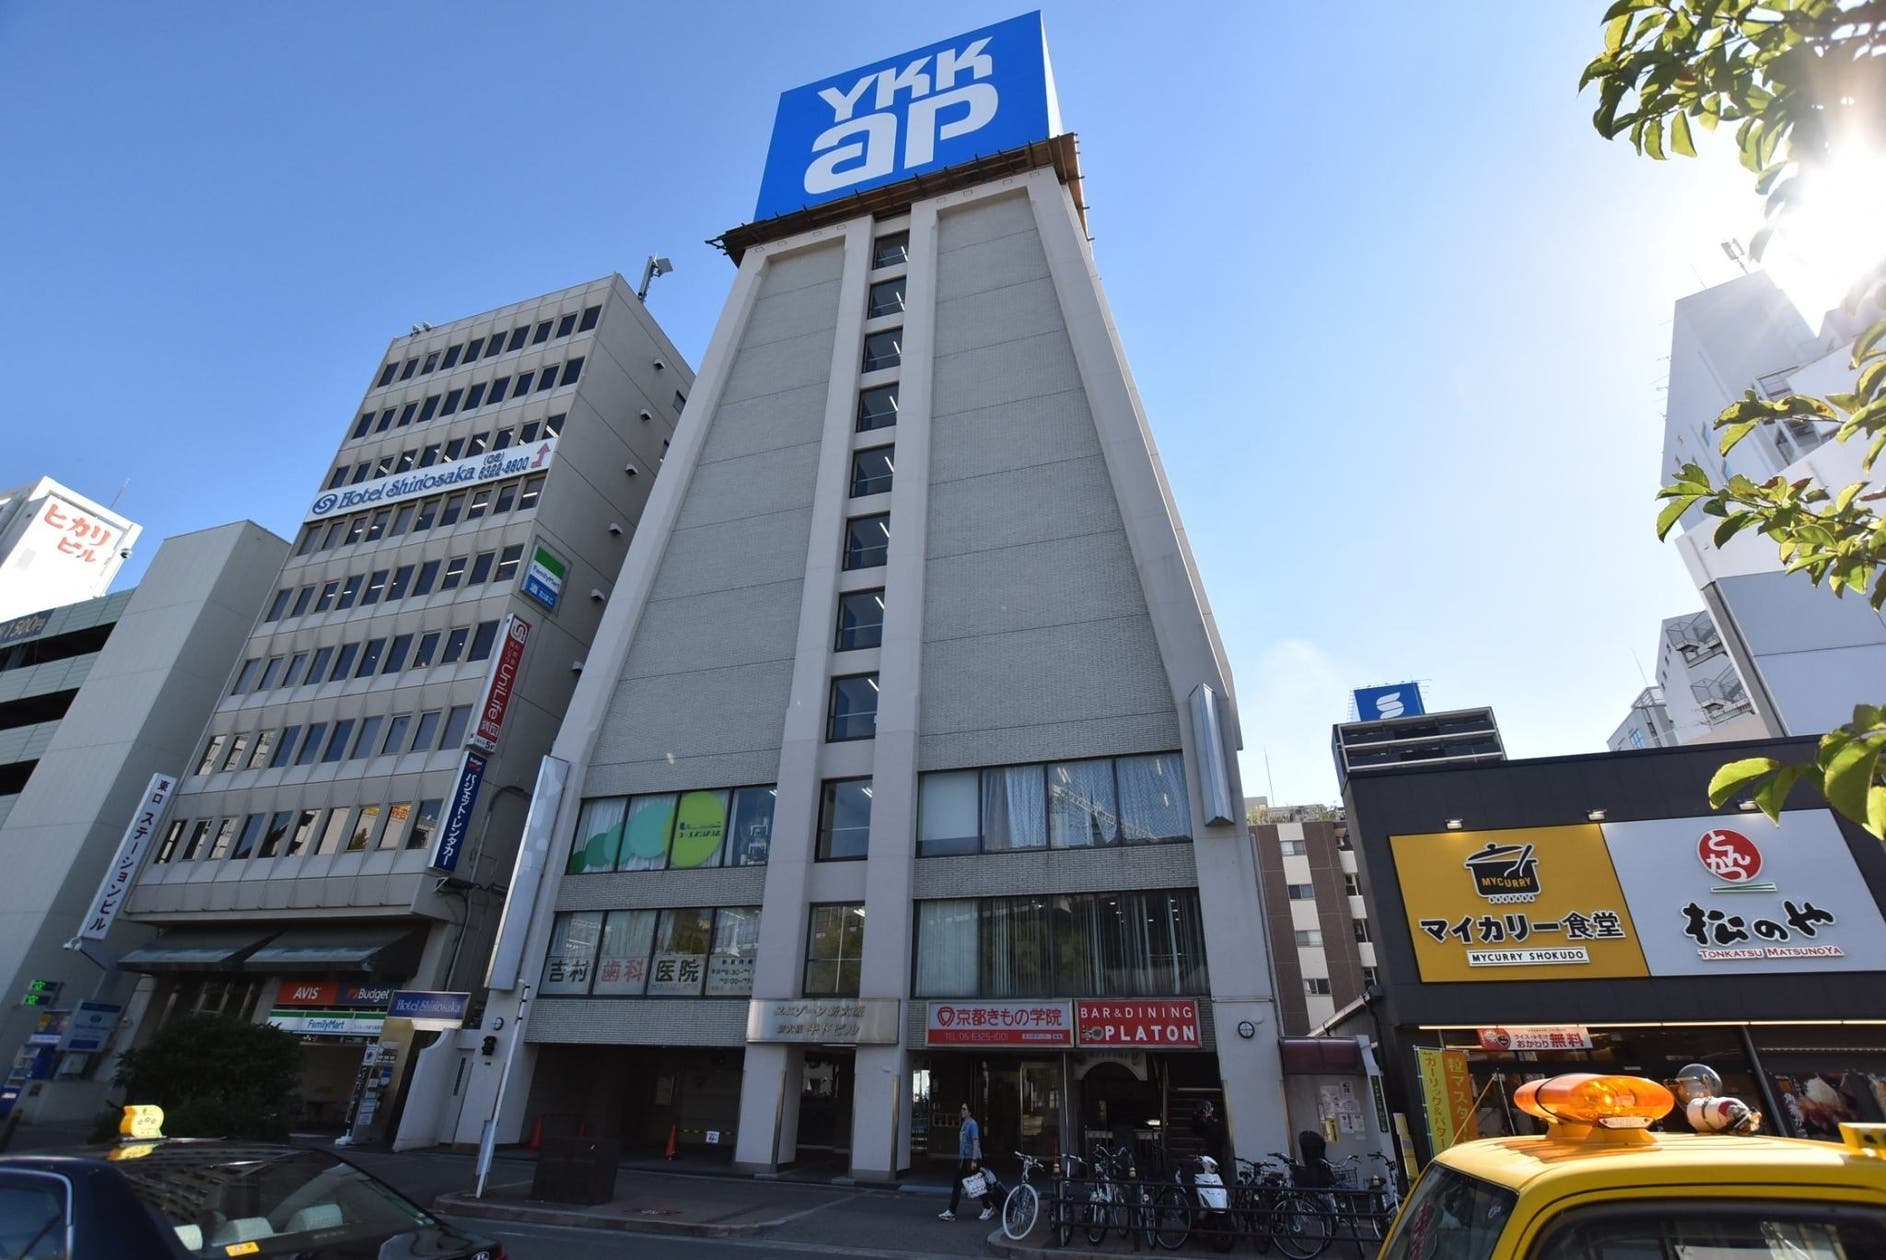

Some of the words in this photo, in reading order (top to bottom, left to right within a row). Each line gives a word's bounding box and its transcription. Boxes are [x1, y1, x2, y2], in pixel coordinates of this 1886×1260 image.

[817, 36, 993, 123] YKK
[337, 484, 386, 510] Hotel
[386, 464, 475, 498] Shinosaka
[43, 502, 112, 547] ヒカリ
[58, 536, 96, 563] ビル
[532, 564, 560, 589] FamilyMart
[152, 779, 170, 804] 東口
[89, 811, 154, 931] ステーションビル
[1481, 876, 1532, 888] MYCURRY
[1419, 912, 1626, 943] マイカリー食堂
[1682, 900, 1835, 946] 松のや
[1472, 951, 1523, 962] MYCURRY
[1529, 950, 1584, 961] SHOKUDO
[1700, 949, 1763, 959] TONKATSU
[293, 987, 320, 1000] AVIS
[358, 988, 389, 1002] Budget
[307, 1018, 345, 1031] FamilyMart
[955, 1008, 1063, 1027] 京都きもの学院
[1105, 1025, 1195, 1042] PLATON
[1549, 1032, 1585, 1048] 無料
